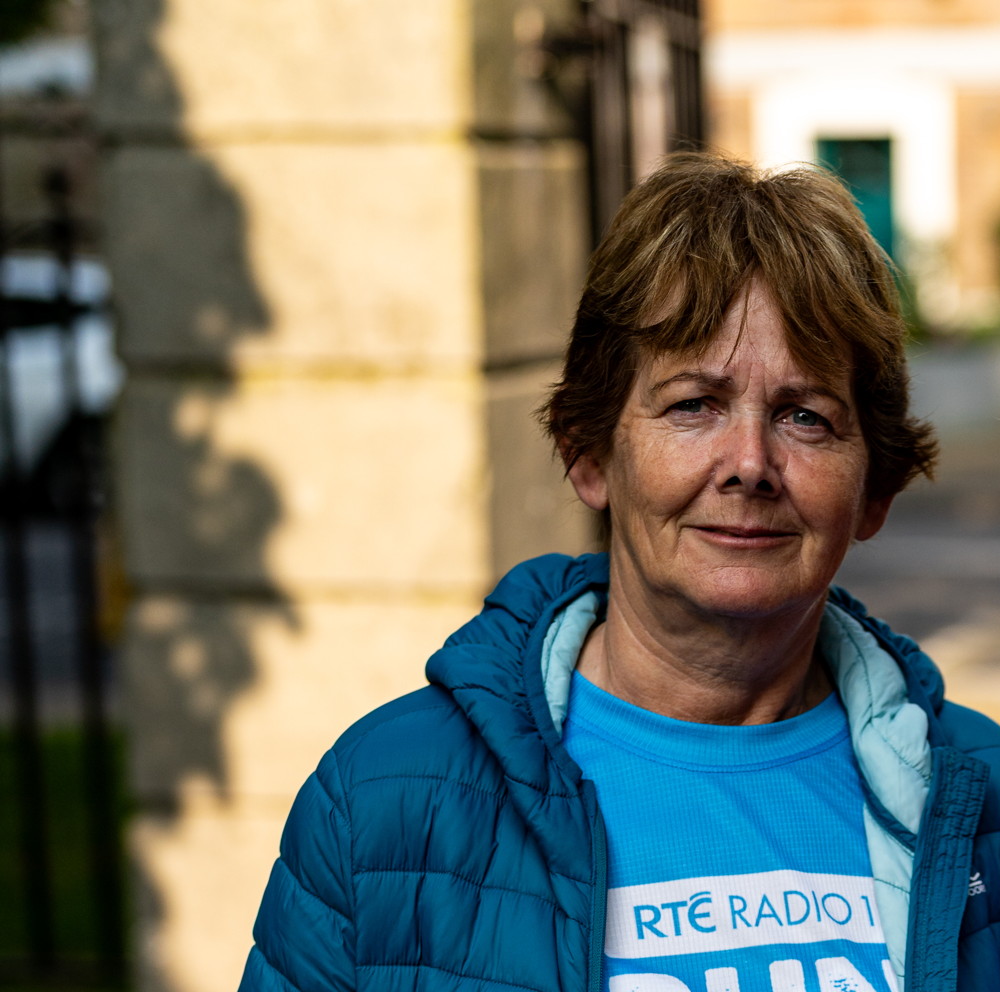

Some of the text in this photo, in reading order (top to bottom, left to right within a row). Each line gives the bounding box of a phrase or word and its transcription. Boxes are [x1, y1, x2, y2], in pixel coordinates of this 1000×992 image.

[633, 890, 876, 939] RTÉ RADIO 1
